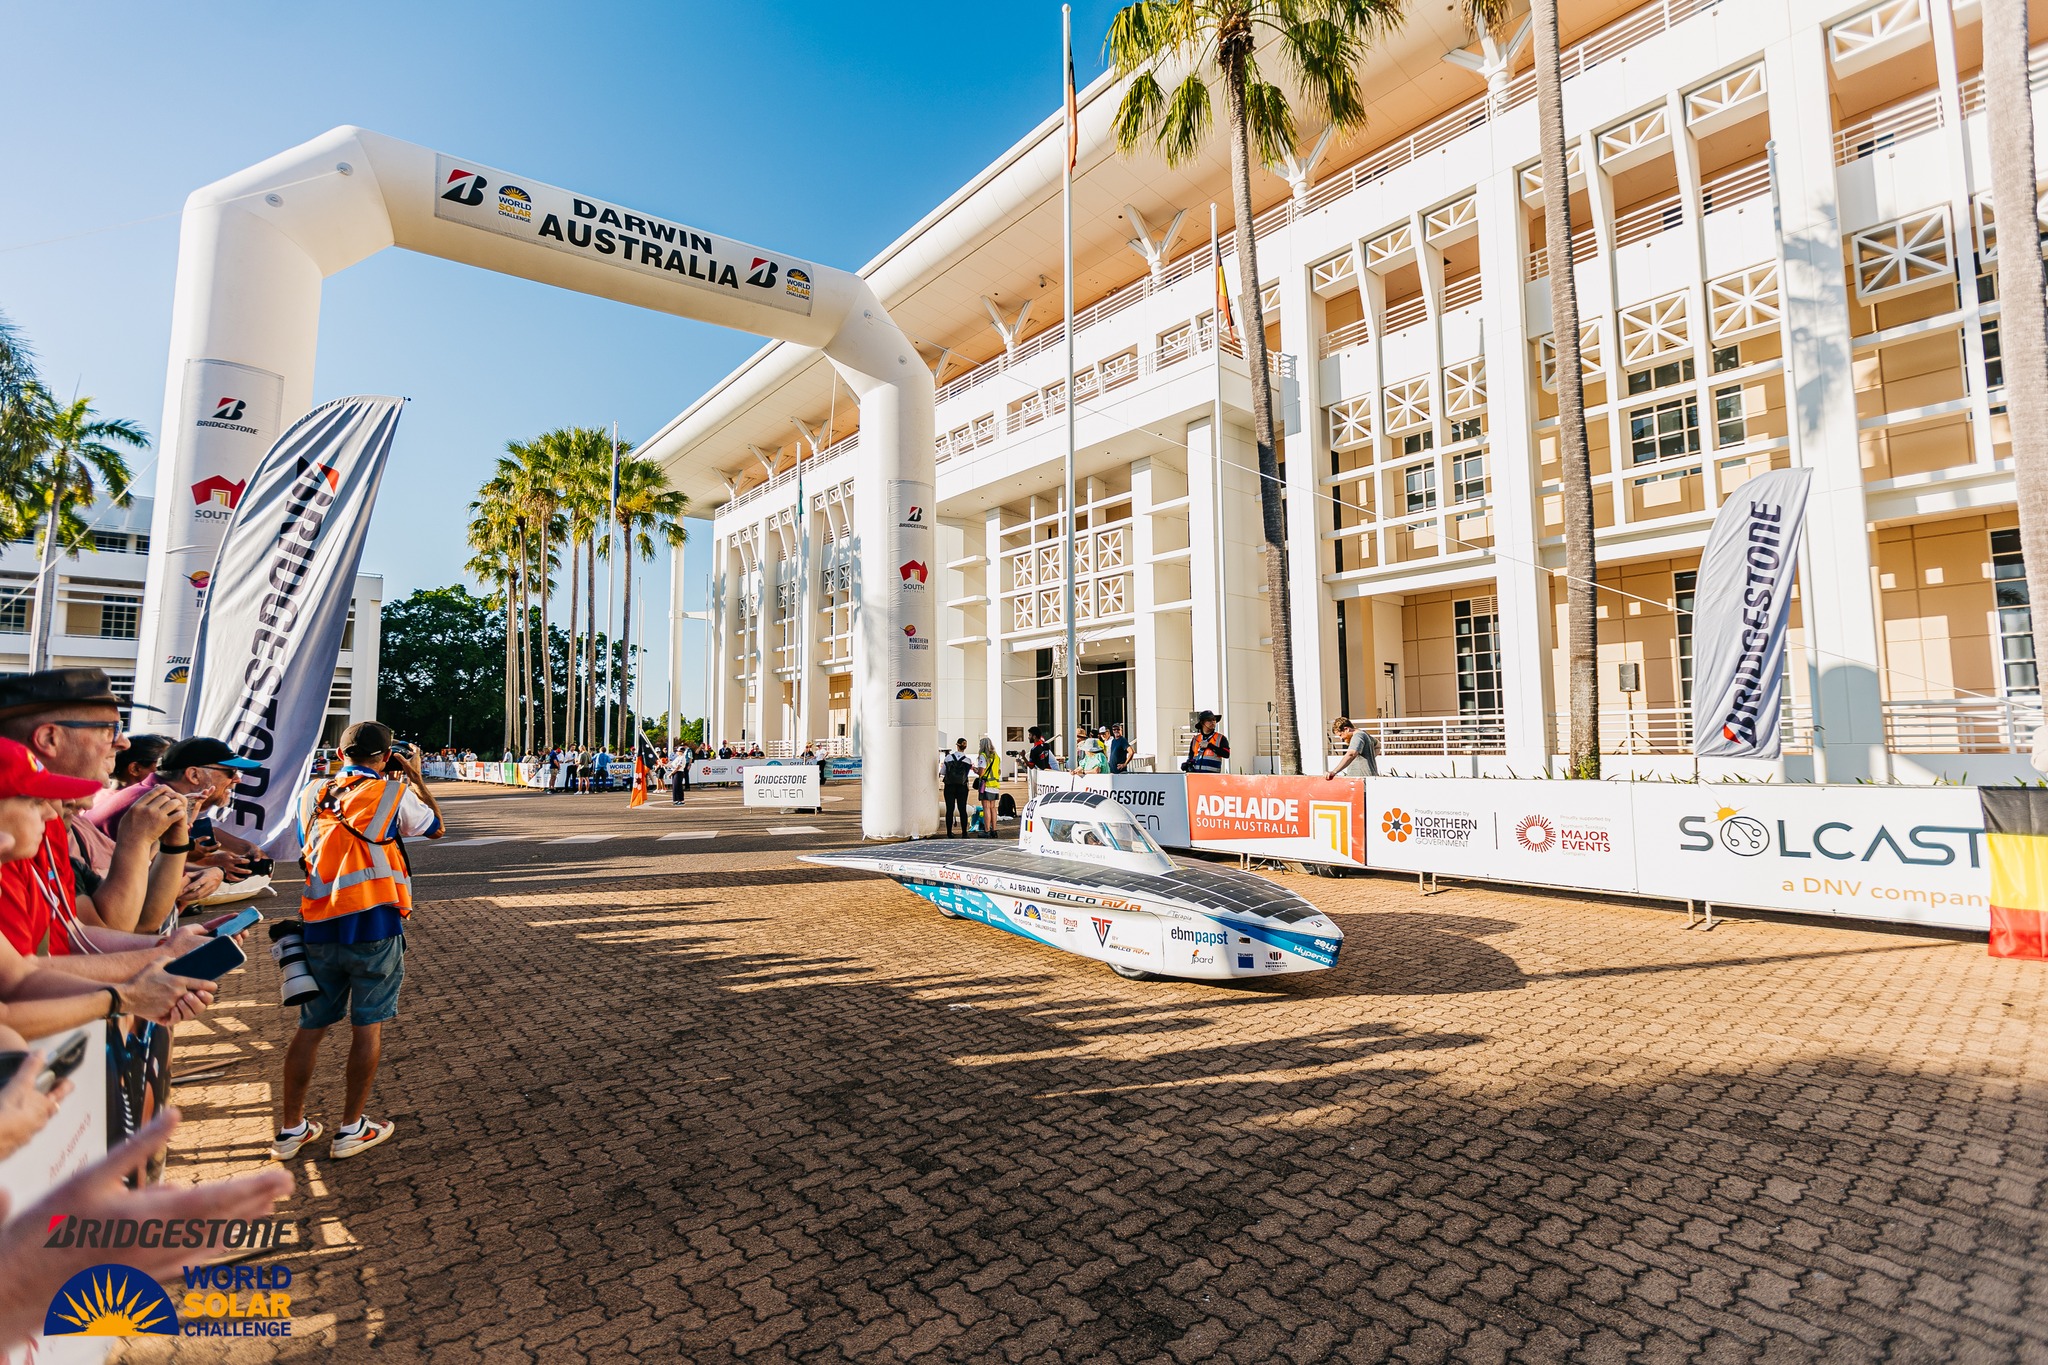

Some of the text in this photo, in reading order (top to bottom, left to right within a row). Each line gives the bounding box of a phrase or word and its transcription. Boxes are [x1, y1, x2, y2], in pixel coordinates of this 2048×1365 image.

[498, 195, 532, 211] WORLD
[498, 203, 531, 218] SOLAR
[498, 211, 532, 223] CHALLENGE
[573, 198, 712, 255] DARWIN
[538, 213, 739, 290] AUSTRALIA
[786, 278, 811, 290] WORLD
[786, 284, 811, 296] SOLAR
[786, 290, 810, 300] CHALLENGE
[196, 420, 260, 435] BRIDGESTONE
[194, 509, 233, 521] SOUT
[899, 522, 928, 530] BRIDGESTONE
[903, 583, 925, 591] SOUTH
[1723, 501, 1782, 748] BRIDGESTONE
[217, 455, 339, 832] BRIDGESTONE
[896, 680, 932, 688] BRIDGESTONE
[754, 774, 807, 784] BRIDGESTONE
[1025, 799, 1037, 820] 99
[1196, 795, 1299, 822] ADELAIDE
[1415, 808, 1433, 816] Proudly
[1196, 817, 1299, 835] SOUTH AUSTRALIA
[1415, 816, 1478, 830] NORTHERN
[1415, 827, 1471, 841] TERRITORY
[1561, 829, 1609, 842] MAJOR
[1415, 838, 1468, 848] GOVERNMENT
[1562, 840, 1612, 853] EVENTS
[1678, 814, 1986, 869] SOLCAST
[939, 870, 961, 881] BOSCH
[1009, 882, 1041, 895] AJ BRAND
[1782, 879, 1795, 892] a
[1803, 877, 1862, 897] DNV
[1041, 906, 1056, 915] WORLD
[1101, 899, 1142, 912] AVIA
[1171, 926, 1228, 946] ebmpapst
[1294, 945, 1333, 965] Hyperion
